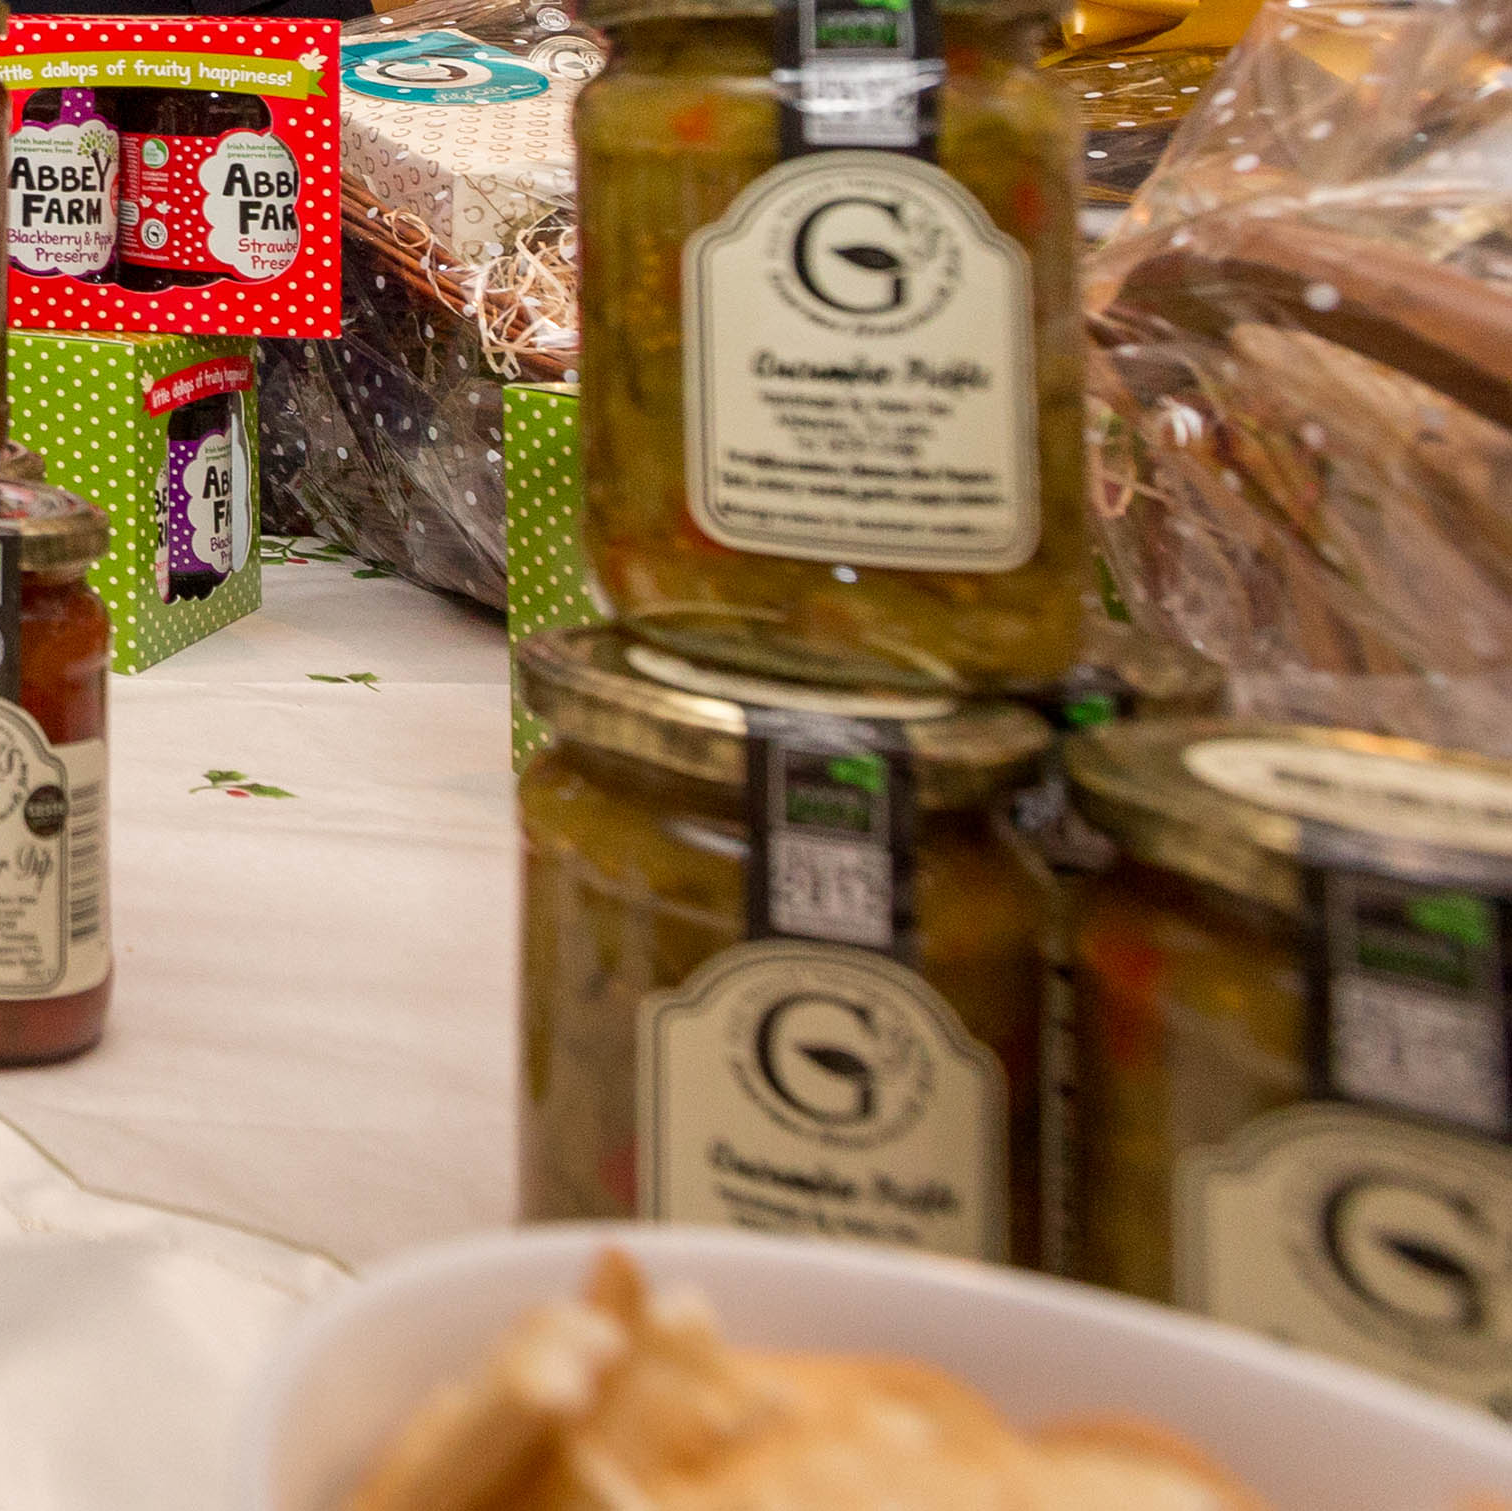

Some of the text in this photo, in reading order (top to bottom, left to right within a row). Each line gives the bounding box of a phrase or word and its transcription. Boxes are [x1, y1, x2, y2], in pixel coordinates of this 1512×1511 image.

[41, 61, 98, 82] dollops
[106, 59, 126, 74] of
[133, 60, 192, 85] fruity
[198, 62, 292, 88] happiness!
[8, 156, 115, 192] ABBEY
[223, 163, 298, 198] ABB
[22, 193, 102, 227] FARM
[239, 200, 298, 235] FAR
[8, 229, 113, 251] Blackberry & Apple
[238, 238, 298, 253] Strawbe
[35, 248, 99, 263] Preserve
[195, 374, 204, 388] of
